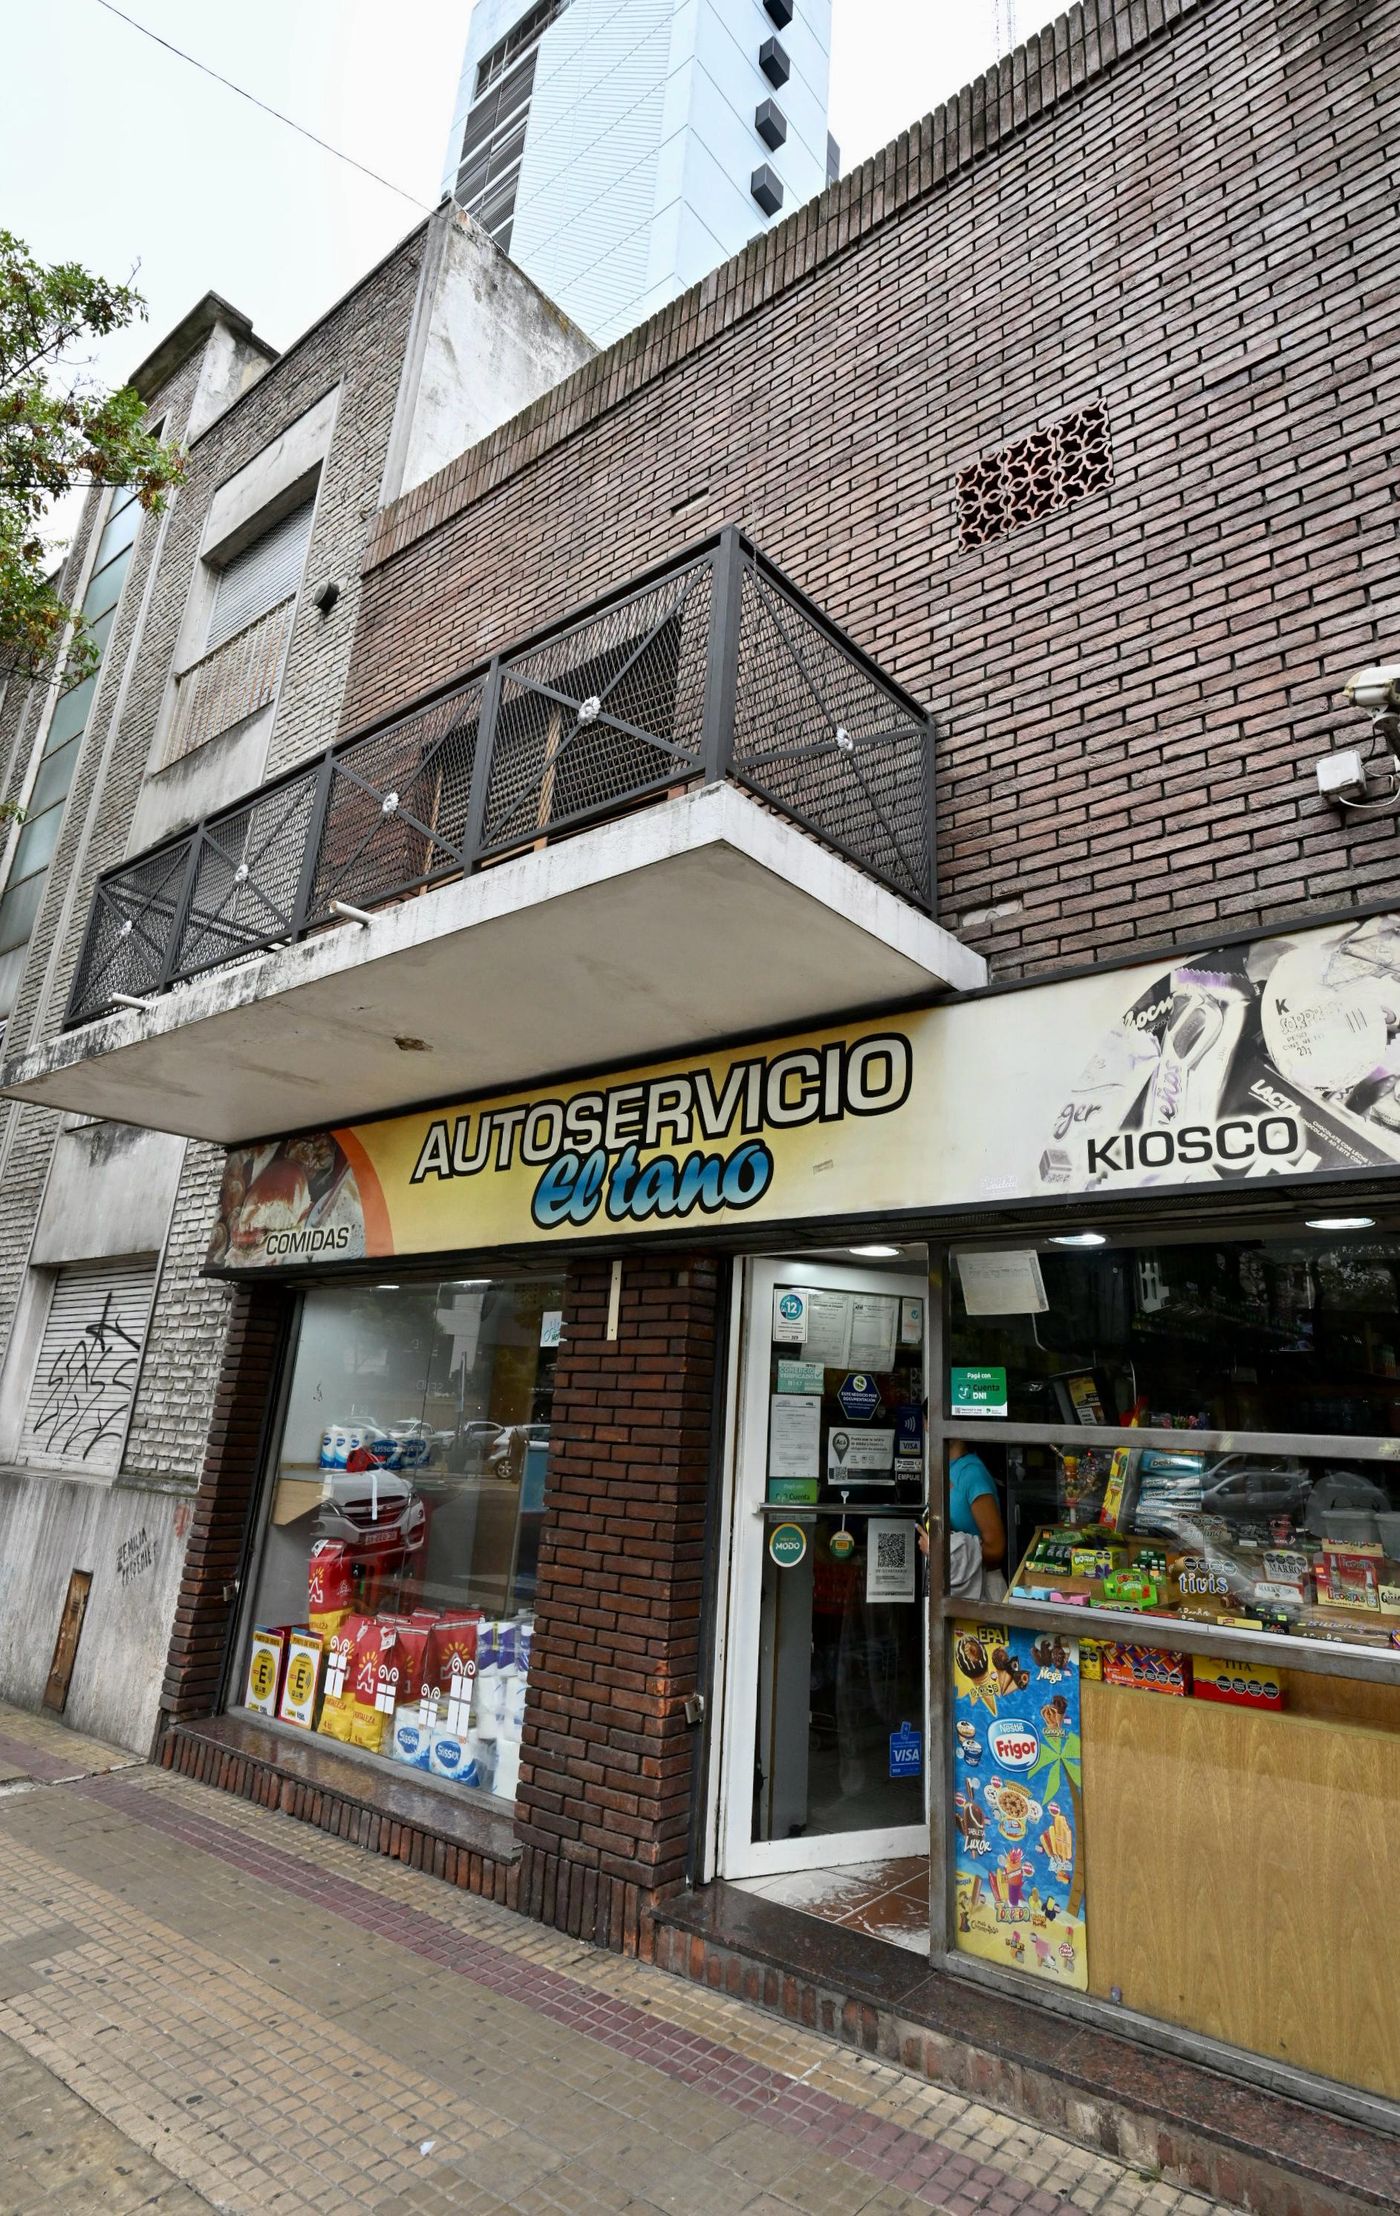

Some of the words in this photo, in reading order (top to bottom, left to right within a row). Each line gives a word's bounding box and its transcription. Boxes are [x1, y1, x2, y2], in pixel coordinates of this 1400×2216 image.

[409, 1032, 913, 1185] AUTOSERVICIO
[1087, 1116, 1299, 1174] KIOSCO
[605, 1138, 774, 1222] tano
[266, 1227, 350, 1256] COMIDAS
[972, 1391, 987, 1400] DNI
[903, 1442, 918, 1450] VISA
[775, 1542, 801, 1551] MODO
[978, 1625, 1009, 1646] EPA!
[1036, 1666, 1063, 1684] Mega
[892, 1748, 920, 1762] VISA
[995, 1739, 1037, 1760] Frigor
